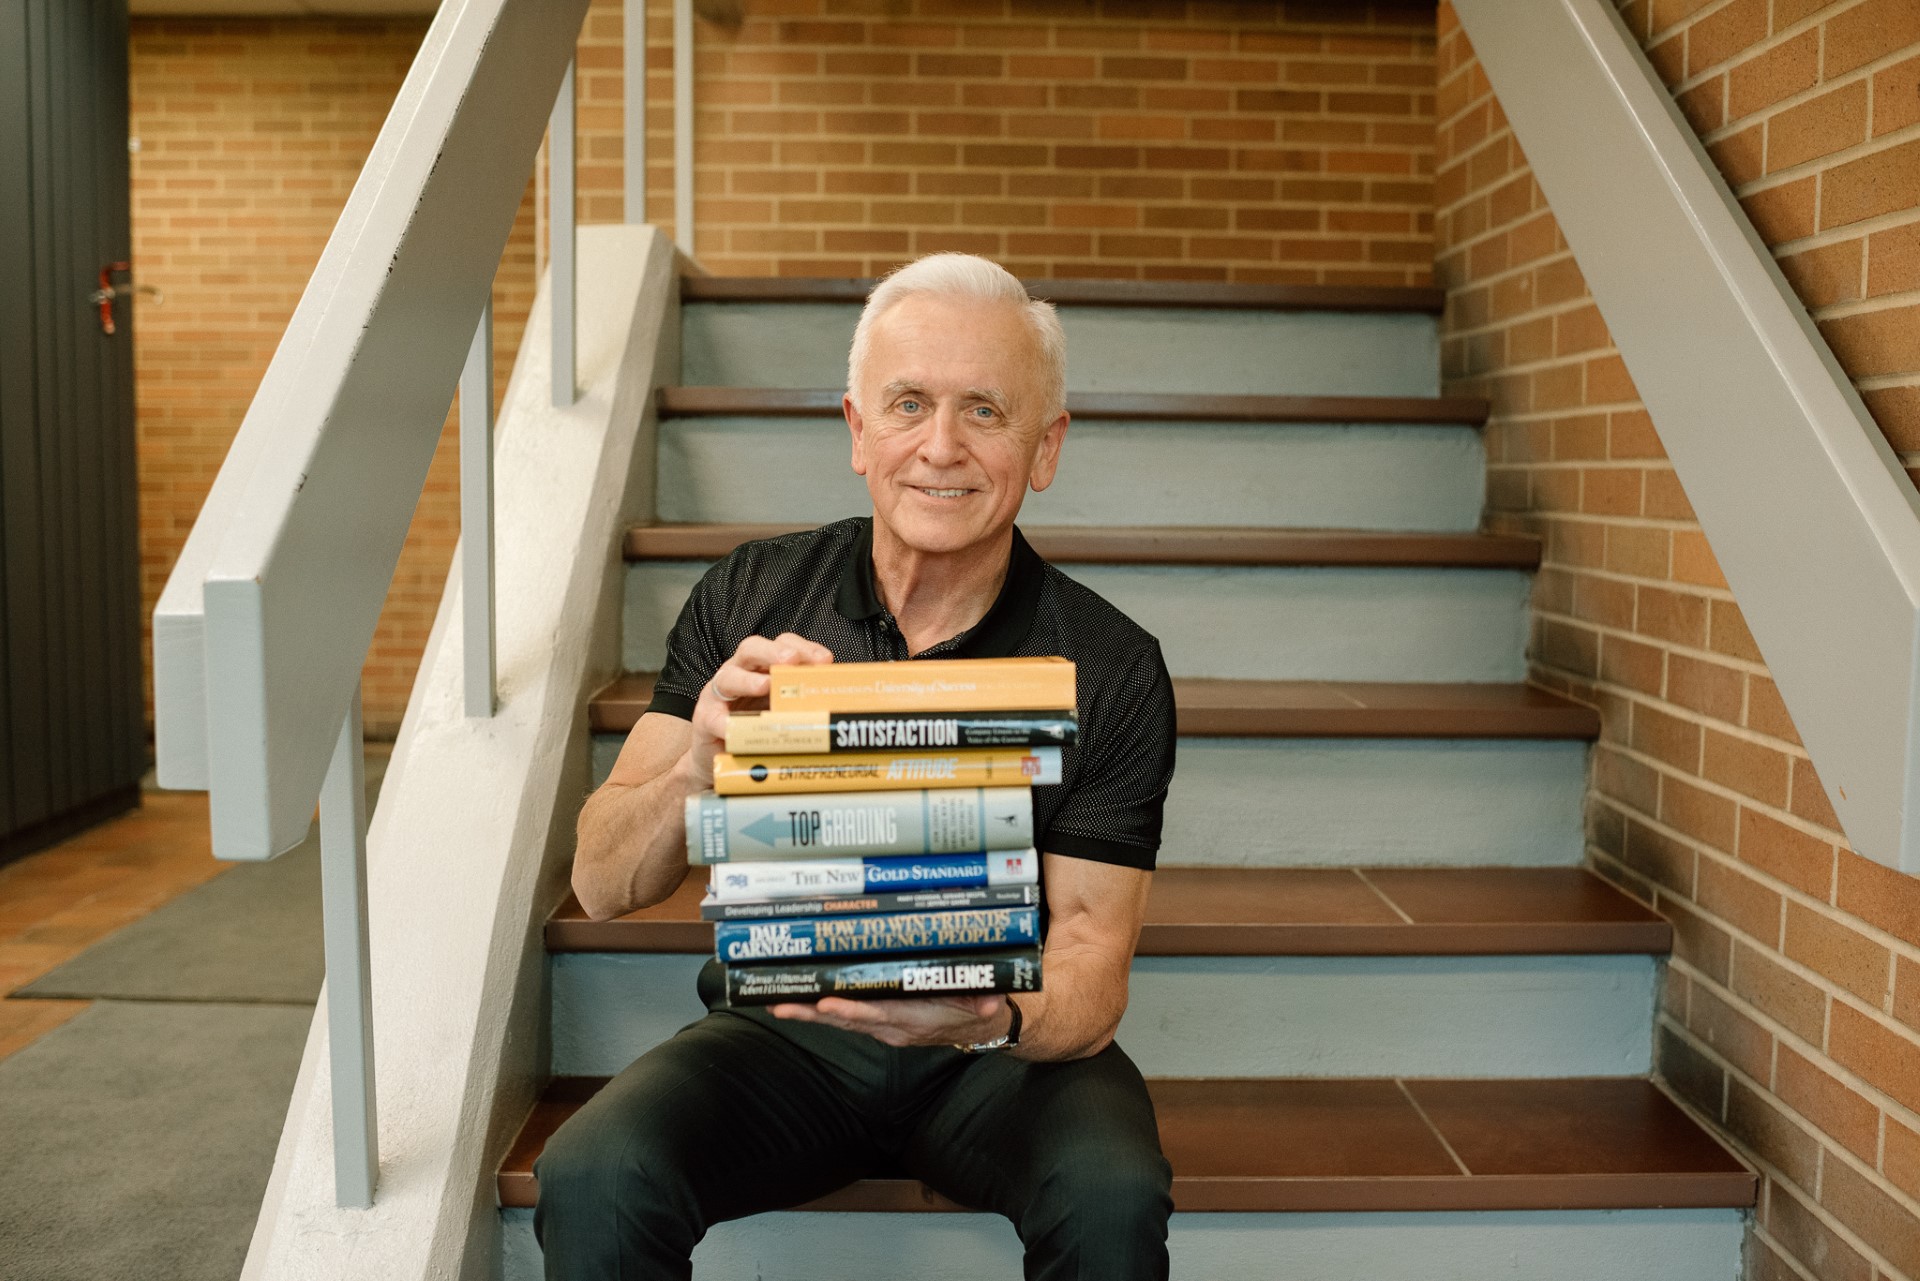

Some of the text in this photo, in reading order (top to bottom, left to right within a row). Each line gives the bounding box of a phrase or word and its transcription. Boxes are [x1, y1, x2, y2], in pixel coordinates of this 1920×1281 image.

[837, 719, 958, 747] SATISFACTION
[886, 757, 958, 780] ATTITUDE
[788, 807, 898, 847] TOPGRADING
[725, 899, 878, 916] Developing Leadership CHARACTER
[749, 923, 792, 942] DALE
[815, 917, 860, 939] HOW
[861, 916, 887, 936] TO
[887, 913, 926, 934] WIN
[930, 909, 1011, 930] FRIENDS
[728, 937, 812, 960] CARNEGIE
[815, 926, 1007, 953] & INFLUENCE PEOPLE
[834, 974, 847, 991] In
[902, 964, 996, 992] EXCELLENCE
